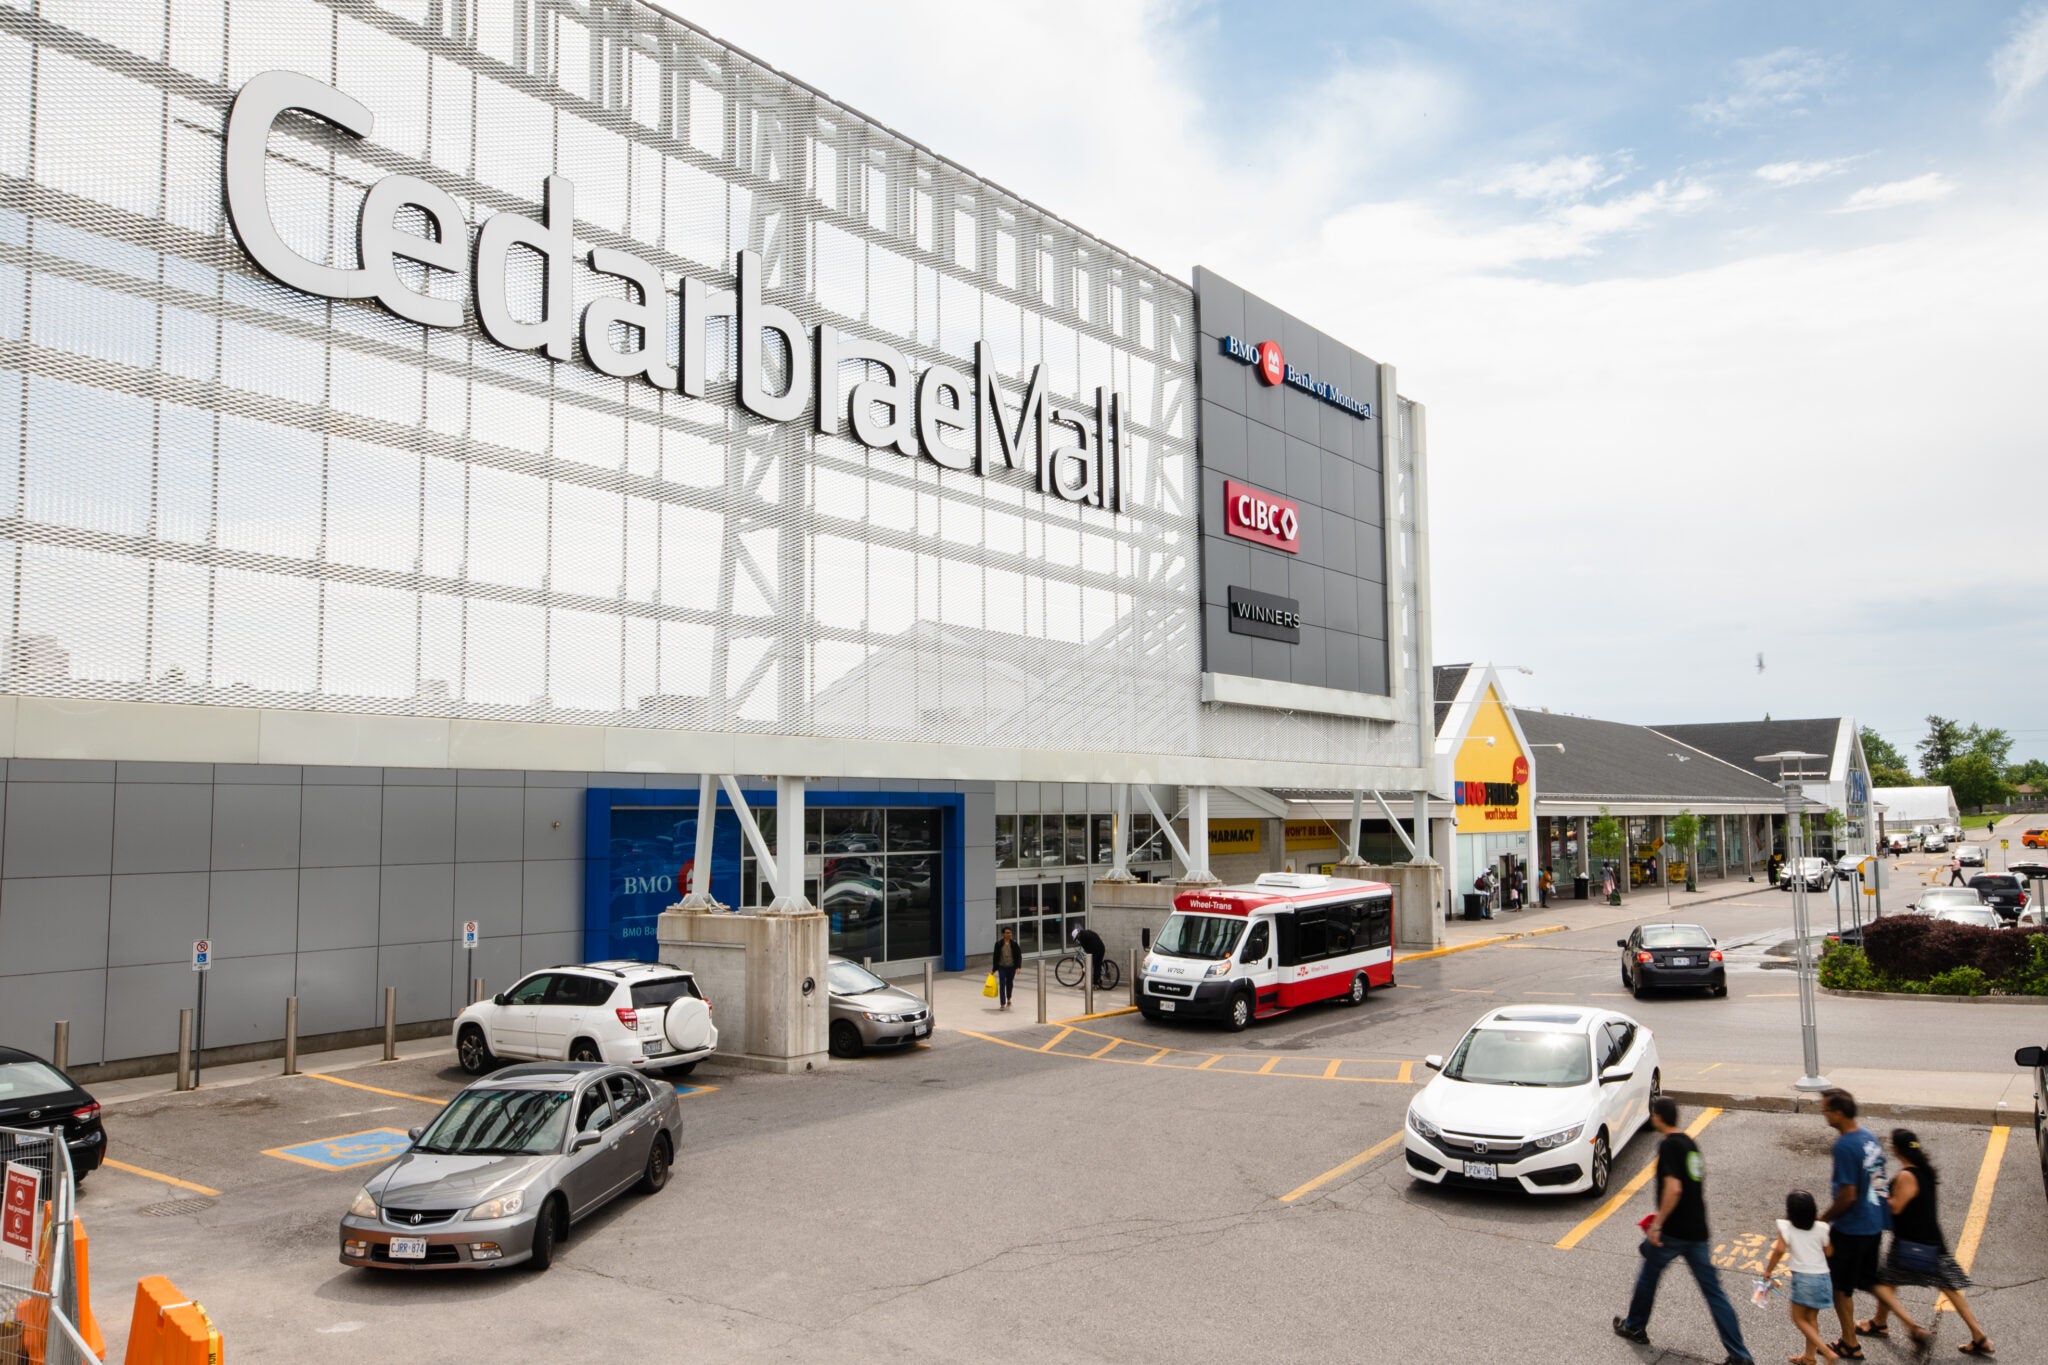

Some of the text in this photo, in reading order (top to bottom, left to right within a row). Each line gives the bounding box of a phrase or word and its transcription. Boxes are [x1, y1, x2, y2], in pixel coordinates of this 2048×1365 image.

[1227, 335, 1262, 365] BMO
[1287, 363, 1373, 419] Bank of Montreal
[1238, 494, 1280, 535] CIBC
[1237, 601, 1300, 629] WINNERS
[623, 875, 672, 895] BMO
[1189, 899, 1232, 911] Wheel-Trans
[622, 927, 642, 938] BMO
